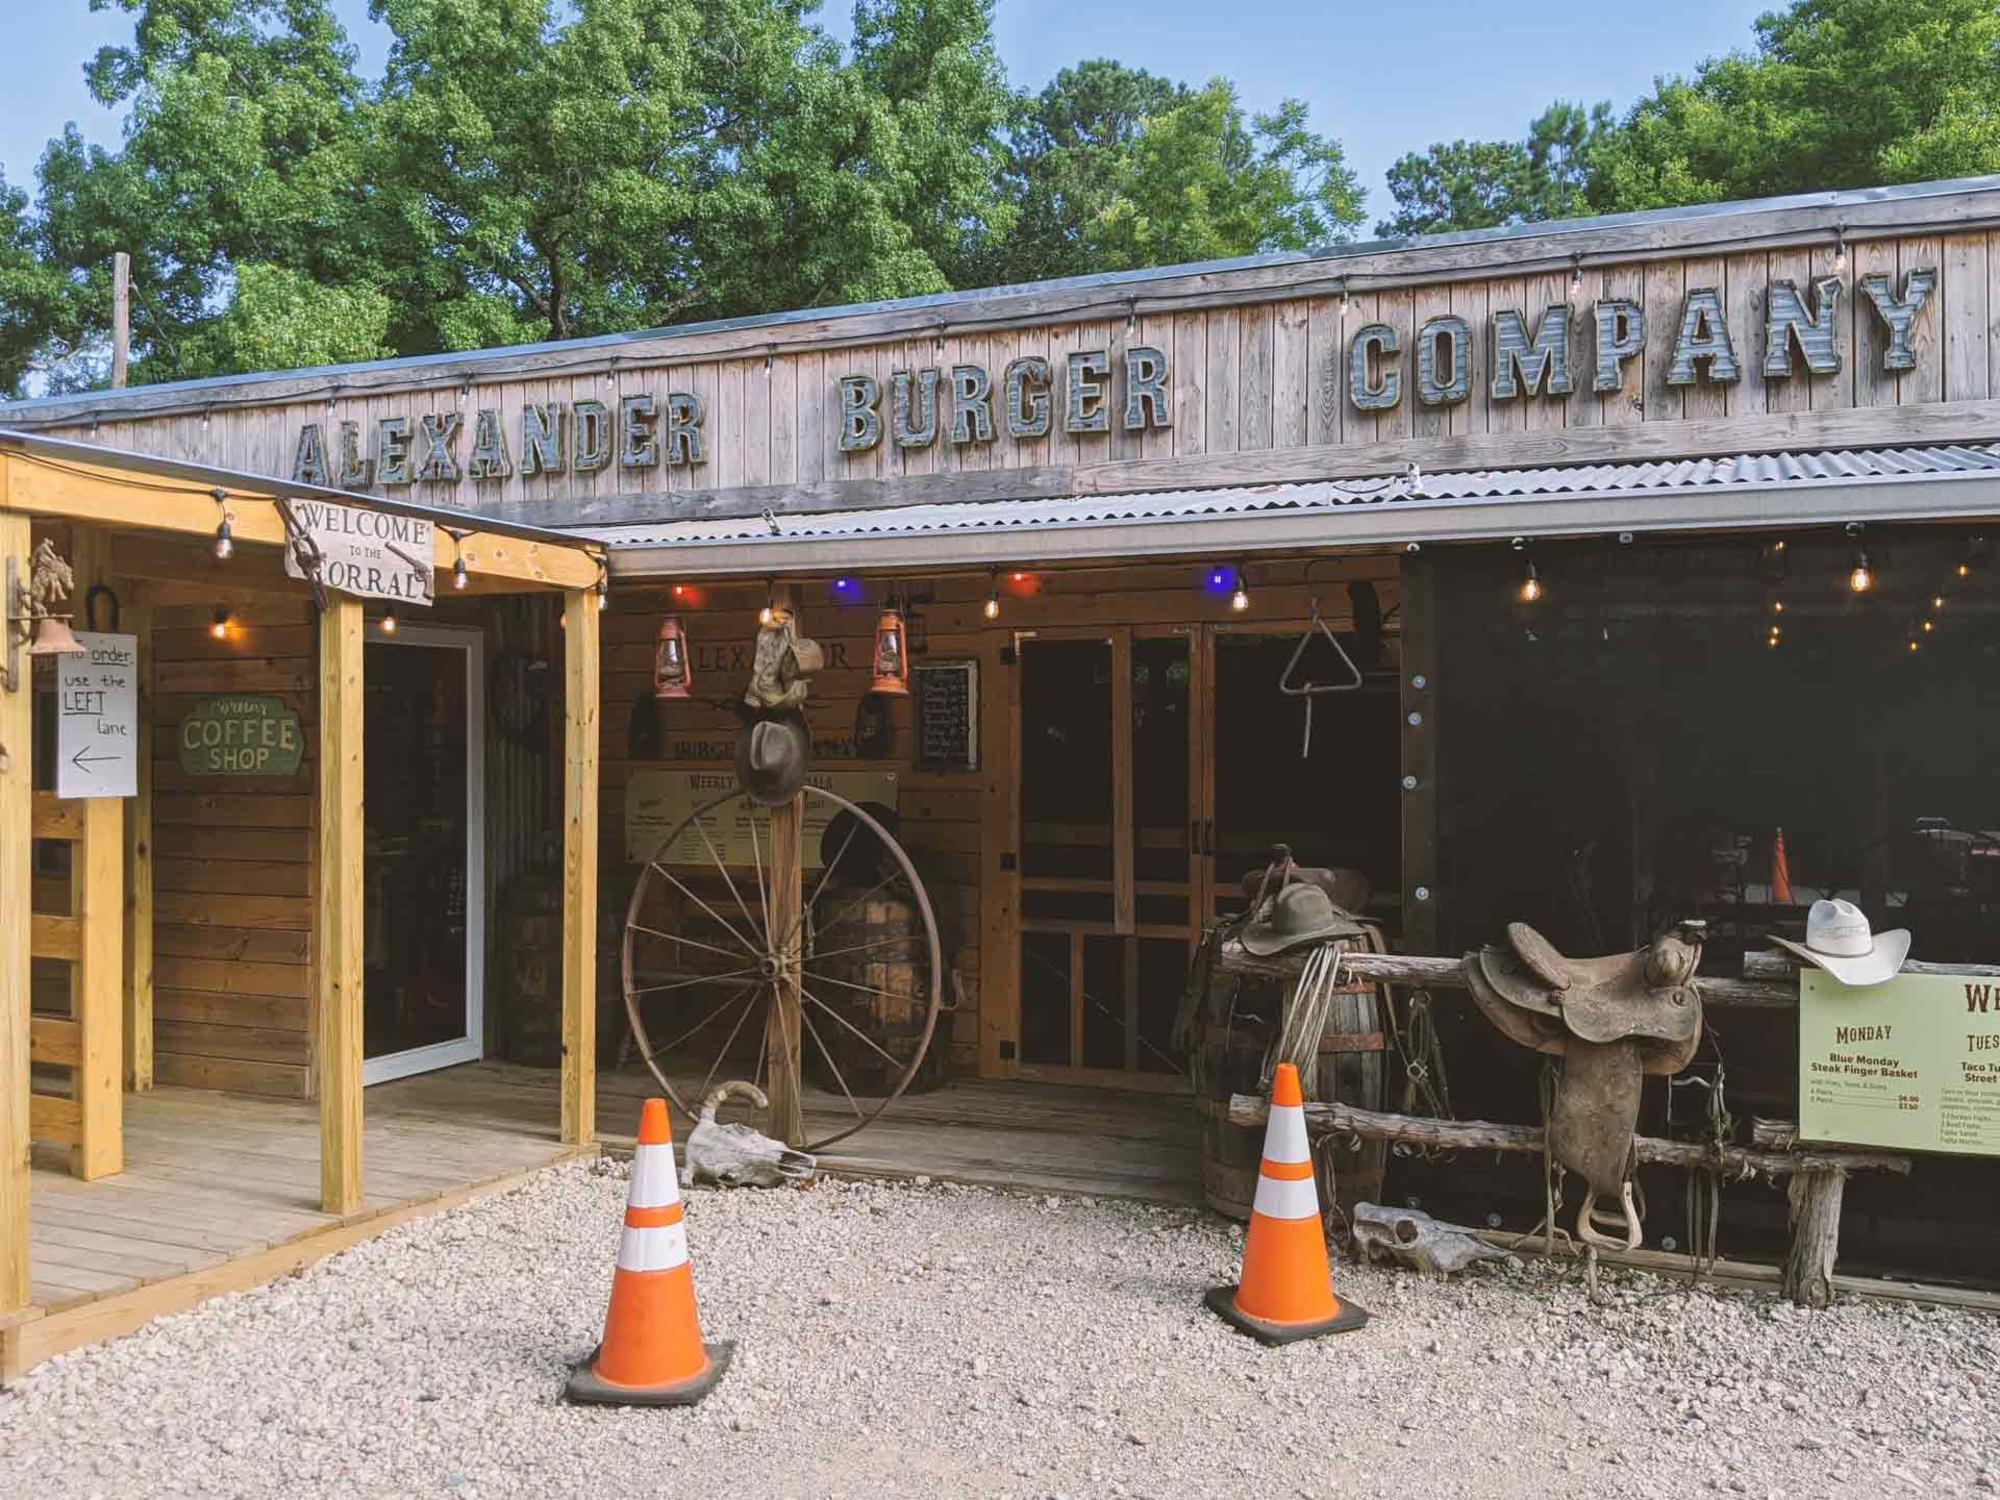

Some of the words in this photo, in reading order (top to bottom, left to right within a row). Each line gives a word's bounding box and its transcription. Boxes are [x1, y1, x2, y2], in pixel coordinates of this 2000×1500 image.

[292, 393, 707, 486] ALEXANDER
[837, 346, 1173, 451] BURGER
[1350, 266, 1936, 411] COMPANY
[301, 503, 426, 545] WELCOME
[349, 545, 362, 556] TO
[364, 547, 382, 559] THE
[322, 560, 417, 599] ORRAL
[64, 676, 91, 688] use
[100, 675, 126, 688] the
[63, 691, 107, 712] LEFT
[97, 719, 128, 735] lane
[183, 718, 297, 752] COFFEE
[210, 746, 270, 770] SHOP
[1836, 1025, 1892, 1044] MONDAY
[1829, 1053, 1854, 1063] Blue
[1856, 1055, 1899, 1068] Monday
[1961, 1062, 1985, 1072] Taco
[1811, 1062, 1841, 1073] Steak
[1844, 1065, 1878, 1077] Finger
[1881, 1067, 1918, 1079] Basket
[1964, 1073, 1997, 1083] Street
